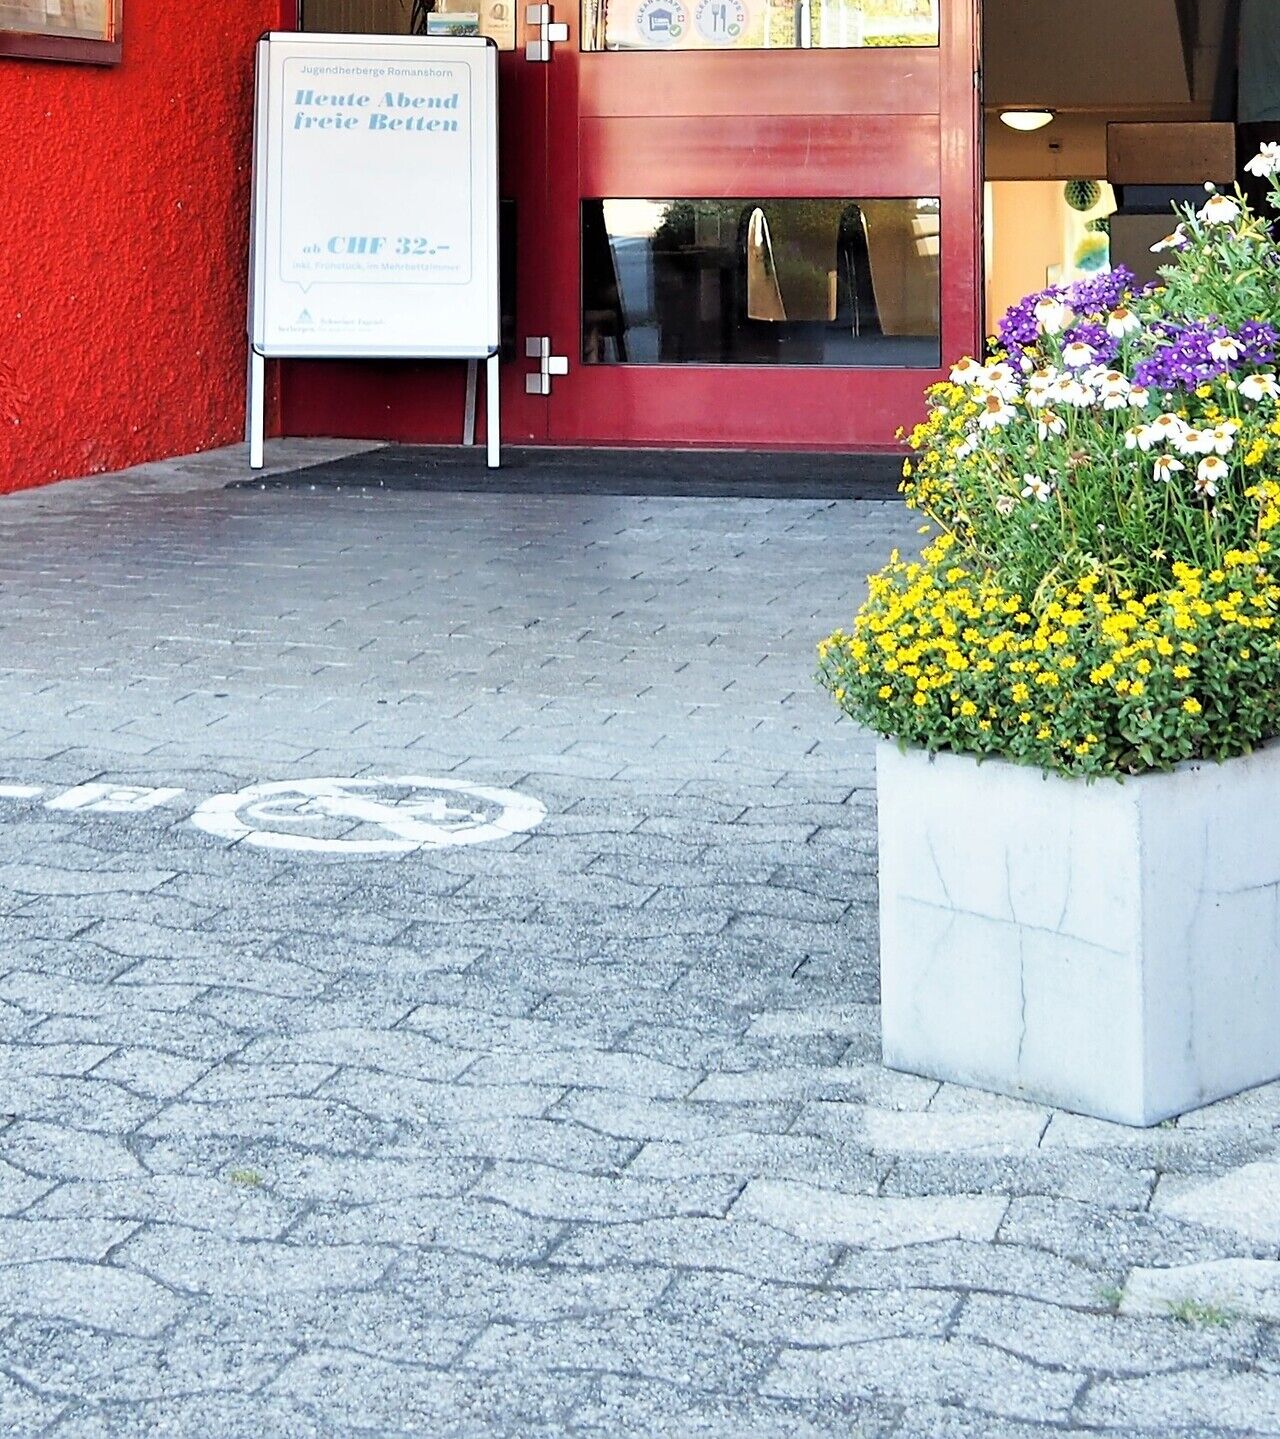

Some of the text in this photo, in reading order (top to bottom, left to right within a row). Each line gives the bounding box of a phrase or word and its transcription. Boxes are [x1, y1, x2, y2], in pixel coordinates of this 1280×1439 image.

[300, 65, 453, 78] Jugendherberge Romanshorn
[295, 90, 459, 109] Heute Abend
[294, 111, 459, 132] freie Betten
[303, 244, 321, 254] ab
[327, 235, 387, 254] CHF
